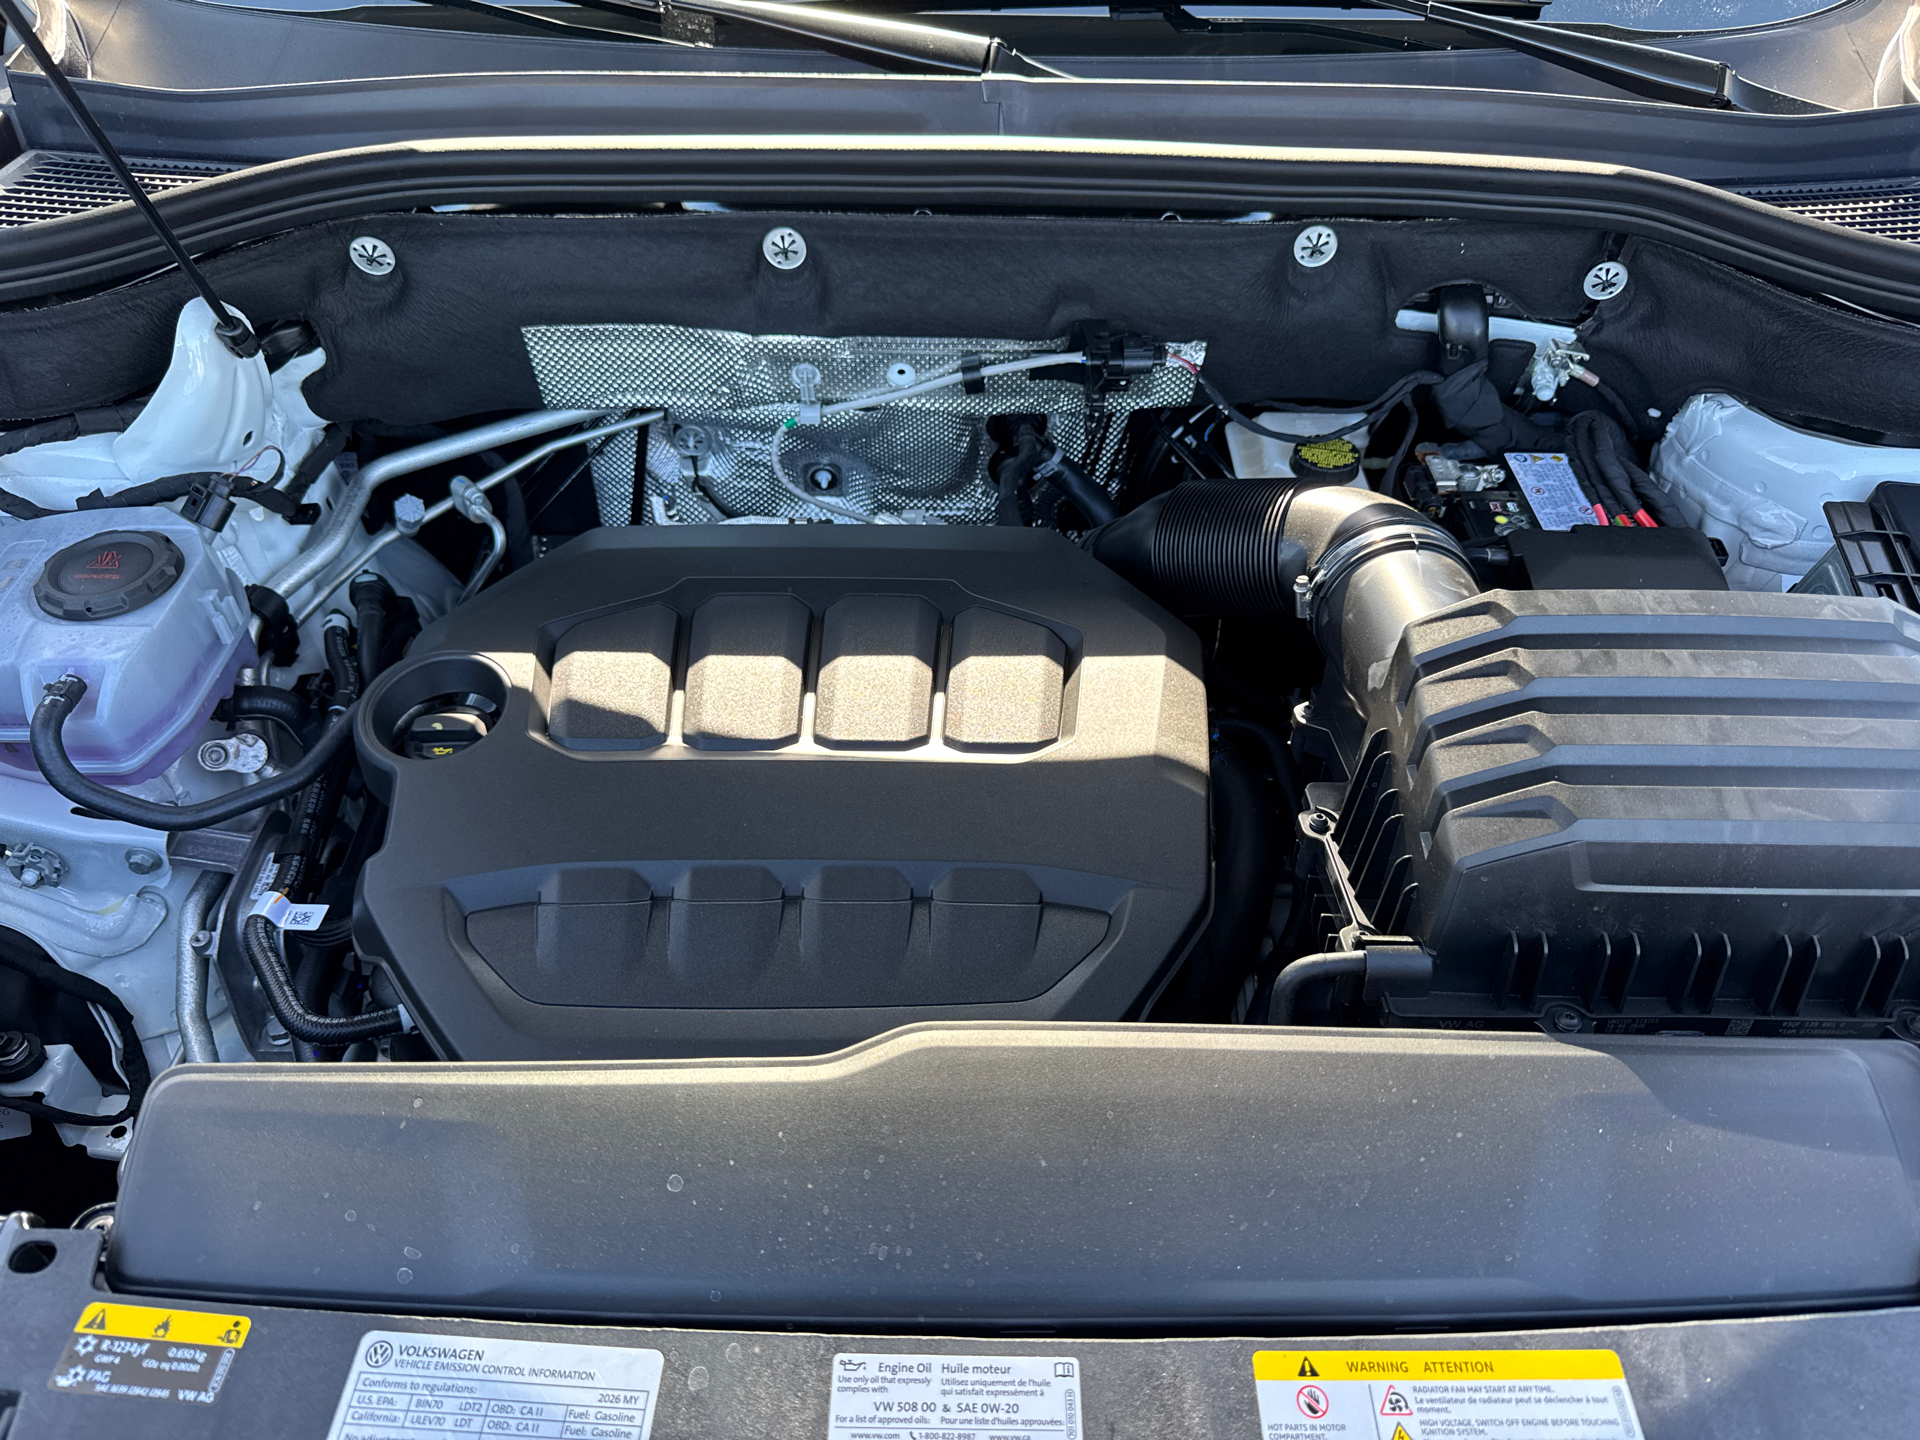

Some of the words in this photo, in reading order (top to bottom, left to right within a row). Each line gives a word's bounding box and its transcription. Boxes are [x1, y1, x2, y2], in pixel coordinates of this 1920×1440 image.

[1439, 1020, 1462, 1028] VW
[1465, 1020, 1485, 1029] AG
[101, 1339, 150, 1357] R-1234yf
[399, 1344, 485, 1361] VOLKSWAGEN
[394, 1359, 433, 1371] VEHICLE
[434, 1361, 480, 1373] EMISSION
[482, 1364, 526, 1376] CONTROL
[528, 1367, 596, 1381] INFORMATION
[879, 1362, 915, 1375] Engine
[917, 1362, 932, 1373] Oil
[941, 1363, 970, 1374] Huile
[972, 1364, 1012, 1375] moteur
[1346, 1361, 1409, 1373] WARNING
[1424, 1361, 1494, 1373] ATTENTION
[86, 1369, 111, 1382] PAG
[838, 1375, 852, 1383] Use
[853, 1376, 869, 1386] only
[870, 1375, 880, 1384] oil
[880, 1376, 896, 1384] that
[897, 1376, 931, 1387] expressly
[362, 1377, 408, 1390] Conforms
[410, 1381, 420, 1391] to
[421, 1381, 477, 1395] regulations:
[941, 1378, 968, 1387] Utilisez
[970, 1379, 1016, 1388] uniquement
[1017, 1379, 1027, 1387] de
[1028, 1379, 1051, 1388] l'huile
[1412, 1385, 1449, 1393] RADIATOR
[1451, 1385, 1466, 1393] FAN
[1484, 1385, 1506, 1393] START
[1518, 1385, 1533, 1393] ANY
[1534, 1385, 1554, 1393] TIME.
[178, 1389, 198, 1401] VW
[197, 1391, 215, 1403] AG
[837, 1386, 870, 1394] complies
[941, 1388, 953, 1397] qui
[955, 1388, 985, 1396] satisfait
[986, 1388, 1038, 1398] expressément
[598, 1393, 621, 1404] 2026
[623, 1395, 640, 1405] MY
[1515, 1397, 1531, 1405] peut
[1543, 1396, 1584, 1404] déclencher
[357, 1394, 375, 1405] U.S.
[376, 1396, 397, 1406] EPA:
[415, 1398, 444, 1410] BIN70
[459, 1401, 483, 1413] LDT2
[491, 1403, 516, 1415] OBD:
[520, 1405, 534, 1416] CA
[568, 1409, 591, 1420] Fuel:
[595, 1410, 635, 1423] Gasoline
[874, 1401, 895, 1412] VW
[897, 1402, 918, 1412] 508
[921, 1402, 937, 1412] 00
[942, 1404, 951, 1412] &
[957, 1402, 978, 1413] SAE
[981, 1402, 1019, 1414] 0W-20
[351, 1410, 400, 1423] California:
[411, 1415, 446, 1427] ULEV70
[454, 1417, 473, 1428] LDT
[487, 1419, 512, 1431] OBD:
[516, 1421, 530, 1432] CA
[564, 1425, 587, 1437] Fuel:
[591, 1426, 632, 1439] Gasoline
[836, 1415, 847, 1423] For
[855, 1415, 867, 1423] list
[868, 1415, 877, 1423] of
[878, 1416, 913, 1425] approved
[914, 1416, 930, 1424] oils:
[941, 1416, 957, 1425] Pour
[975, 1417, 990, 1425] liste
[991, 1417, 1019, 1426] d'huiles
[1020, 1418, 1065, 1427] approuvées:
[1419, 1418, 1438, 1427] HIGH
[1440, 1418, 1475, 1428] VOLTAGE,
[1475, 1418, 1504, 1427] SWITCH
[1505, 1418, 1520, 1427] OFF
[1521, 1418, 1549, 1427] ENGINE
[1551, 1418, 1579, 1427] BEFORE
[1581, 1418, 1619, 1427] TOUCHING
[1267, 1423, 1283, 1431] HOT
[1284, 1423, 1308, 1431] PARTS
[1309, 1423, 1318, 1431] IN
[1320, 1423, 1346, 1431] MOTOR
[1421, 1427, 1454, 1436] IGNITION
[1455, 1427, 1488, 1436] SYSTEM.
[851, 1432, 900, 1440] www.vw.com
[919, 1431, 975, 1440] 1-800-822-8987
